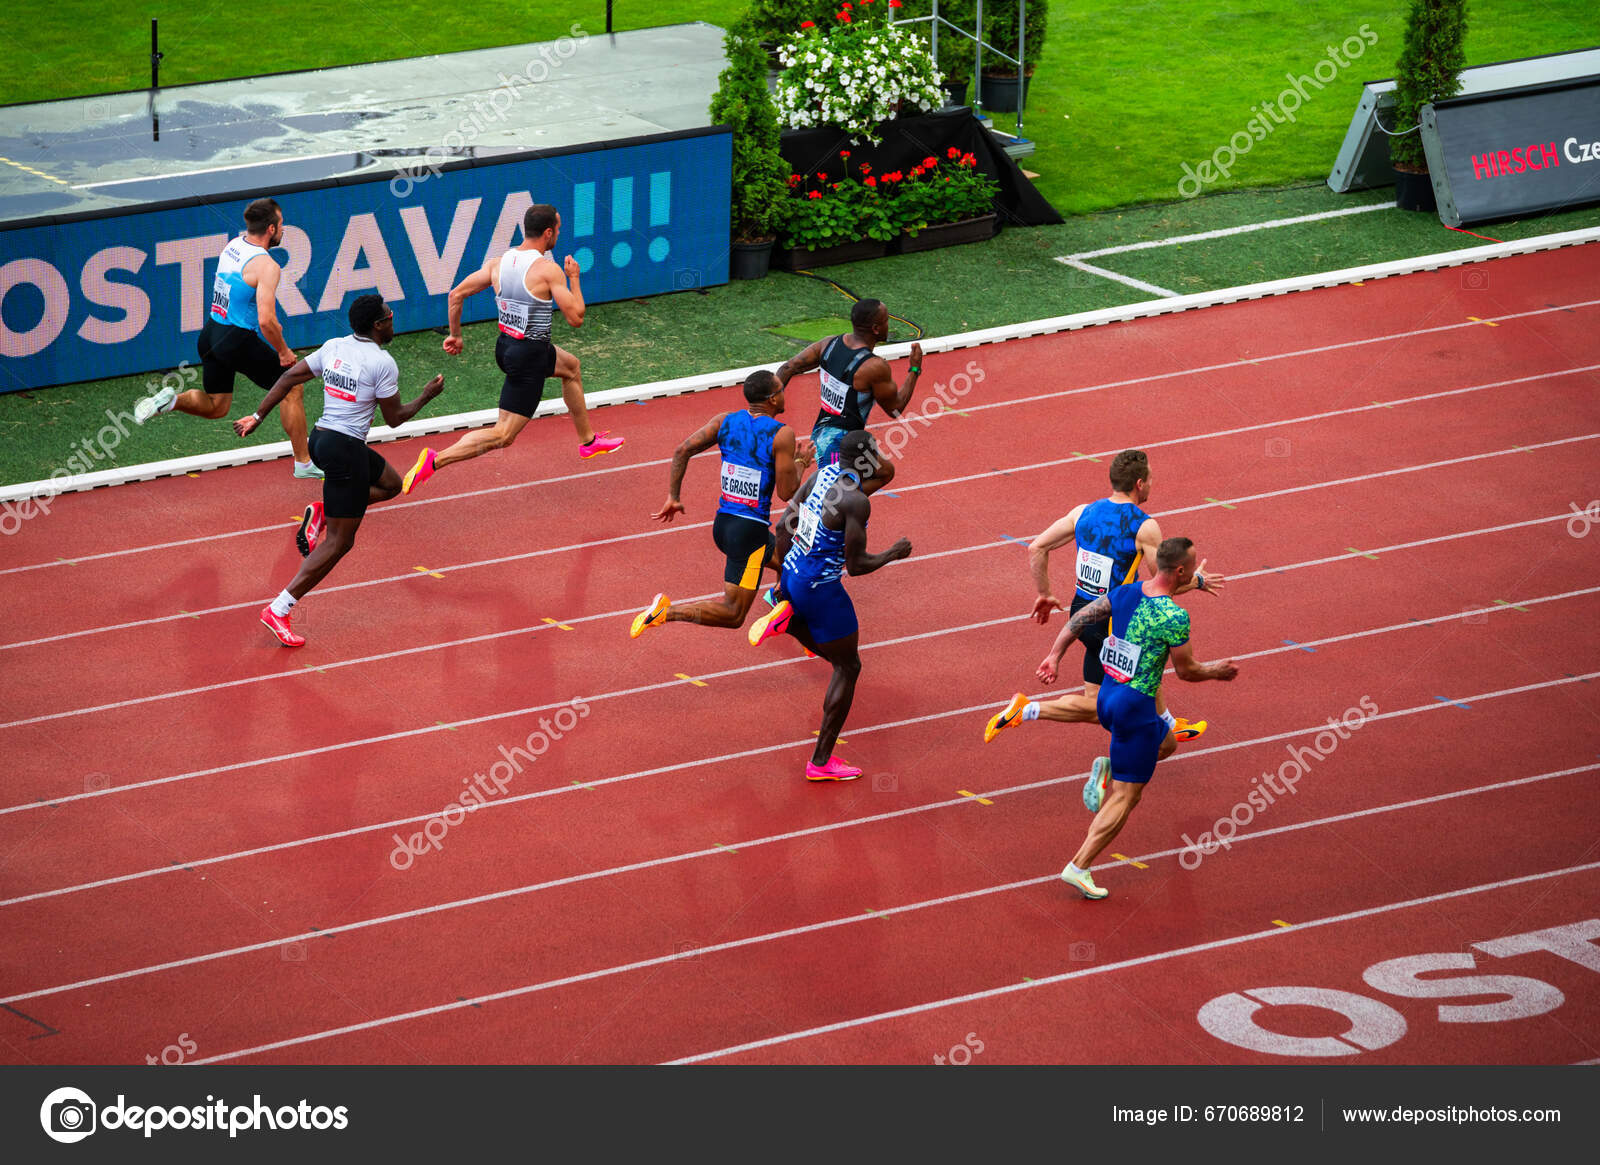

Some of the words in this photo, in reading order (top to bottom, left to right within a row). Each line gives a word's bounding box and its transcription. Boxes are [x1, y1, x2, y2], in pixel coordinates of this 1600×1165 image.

[1472, 141, 1560, 180] HIRSCH
[730, 478, 758, 497] GRASSE
[1080, 563, 1101, 584] VOLKO
[1102, 646, 1133, 674] VELEBA
